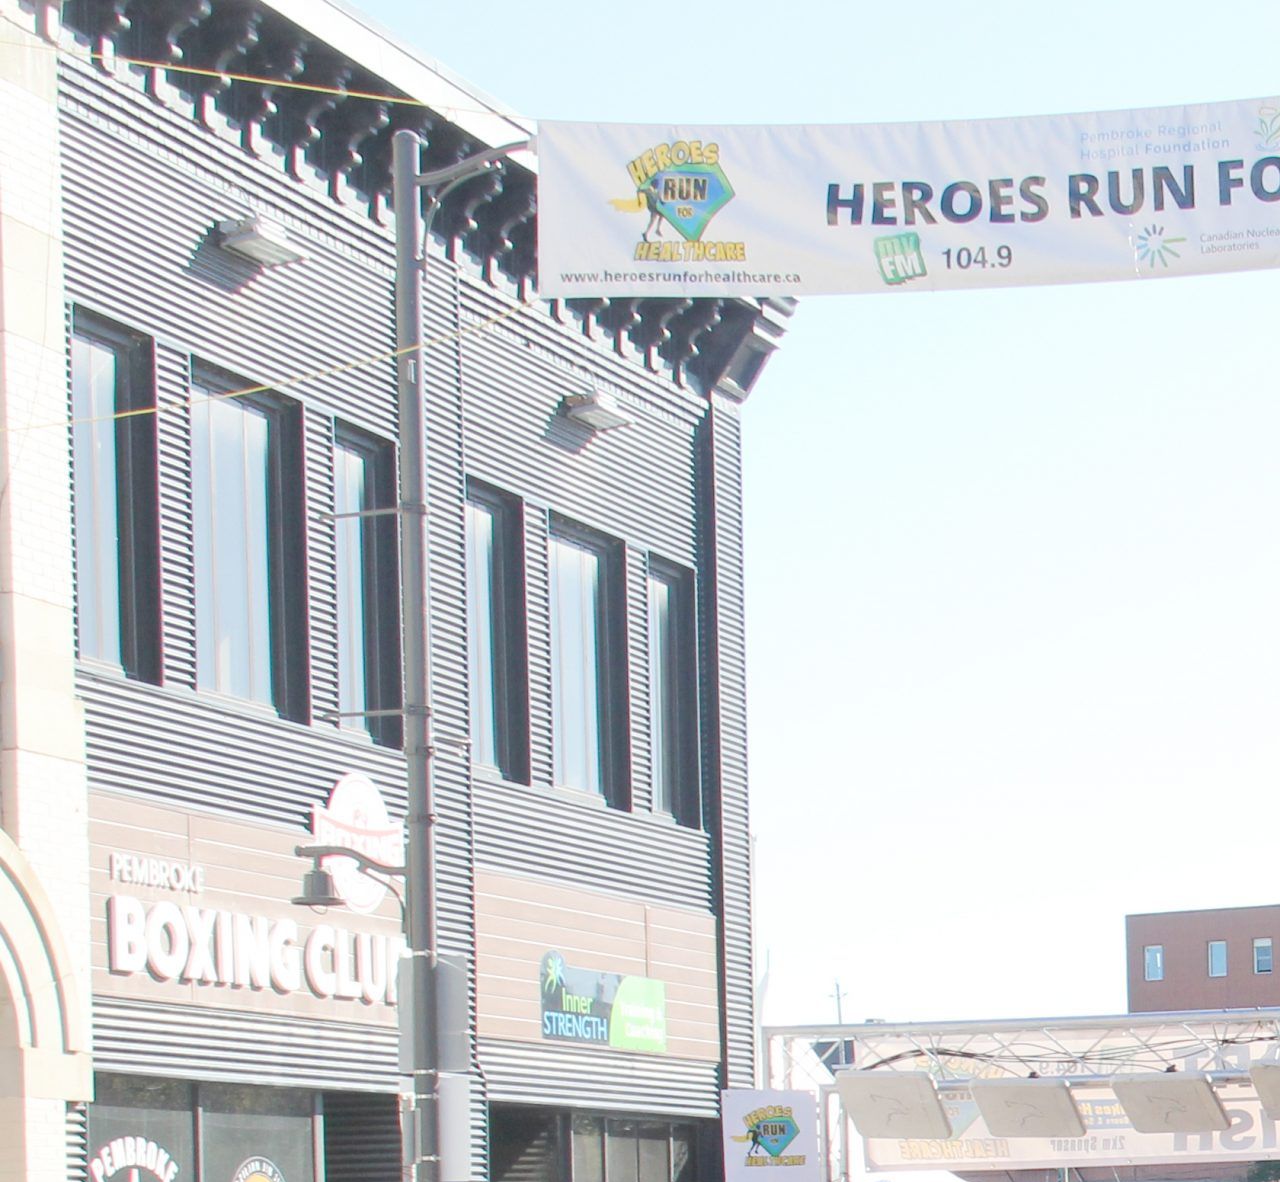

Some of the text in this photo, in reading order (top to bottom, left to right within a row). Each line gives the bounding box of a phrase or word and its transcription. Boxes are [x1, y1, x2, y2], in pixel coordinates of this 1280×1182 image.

[1080, 120, 1223, 144] Pembroke Regional
[1079, 137, 1230, 162] Hospital Foundation
[627, 141, 719, 186] HEROES
[663, 178, 707, 201] RUN
[827, 176, 1049, 227] HEROES
[1068, 165, 1195, 218] RUN
[1200, 228, 1244, 243] Canadian
[634, 241, 746, 262] HEALTHCARE
[942, 245, 1012, 269] 104.9
[1200, 241, 1260, 255] Laboratories
[561, 268, 801, 285] www.heroesrunforhealthcare.ca
[881, 252, 922, 279] FM
[110, 853, 204, 893] PEMBROKE
[108, 895, 300, 994] BOXING
[562, 987, 593, 1013] Inner
[544, 1011, 608, 1041] STRENGTH
[763, 1124, 786, 1135] RUN
